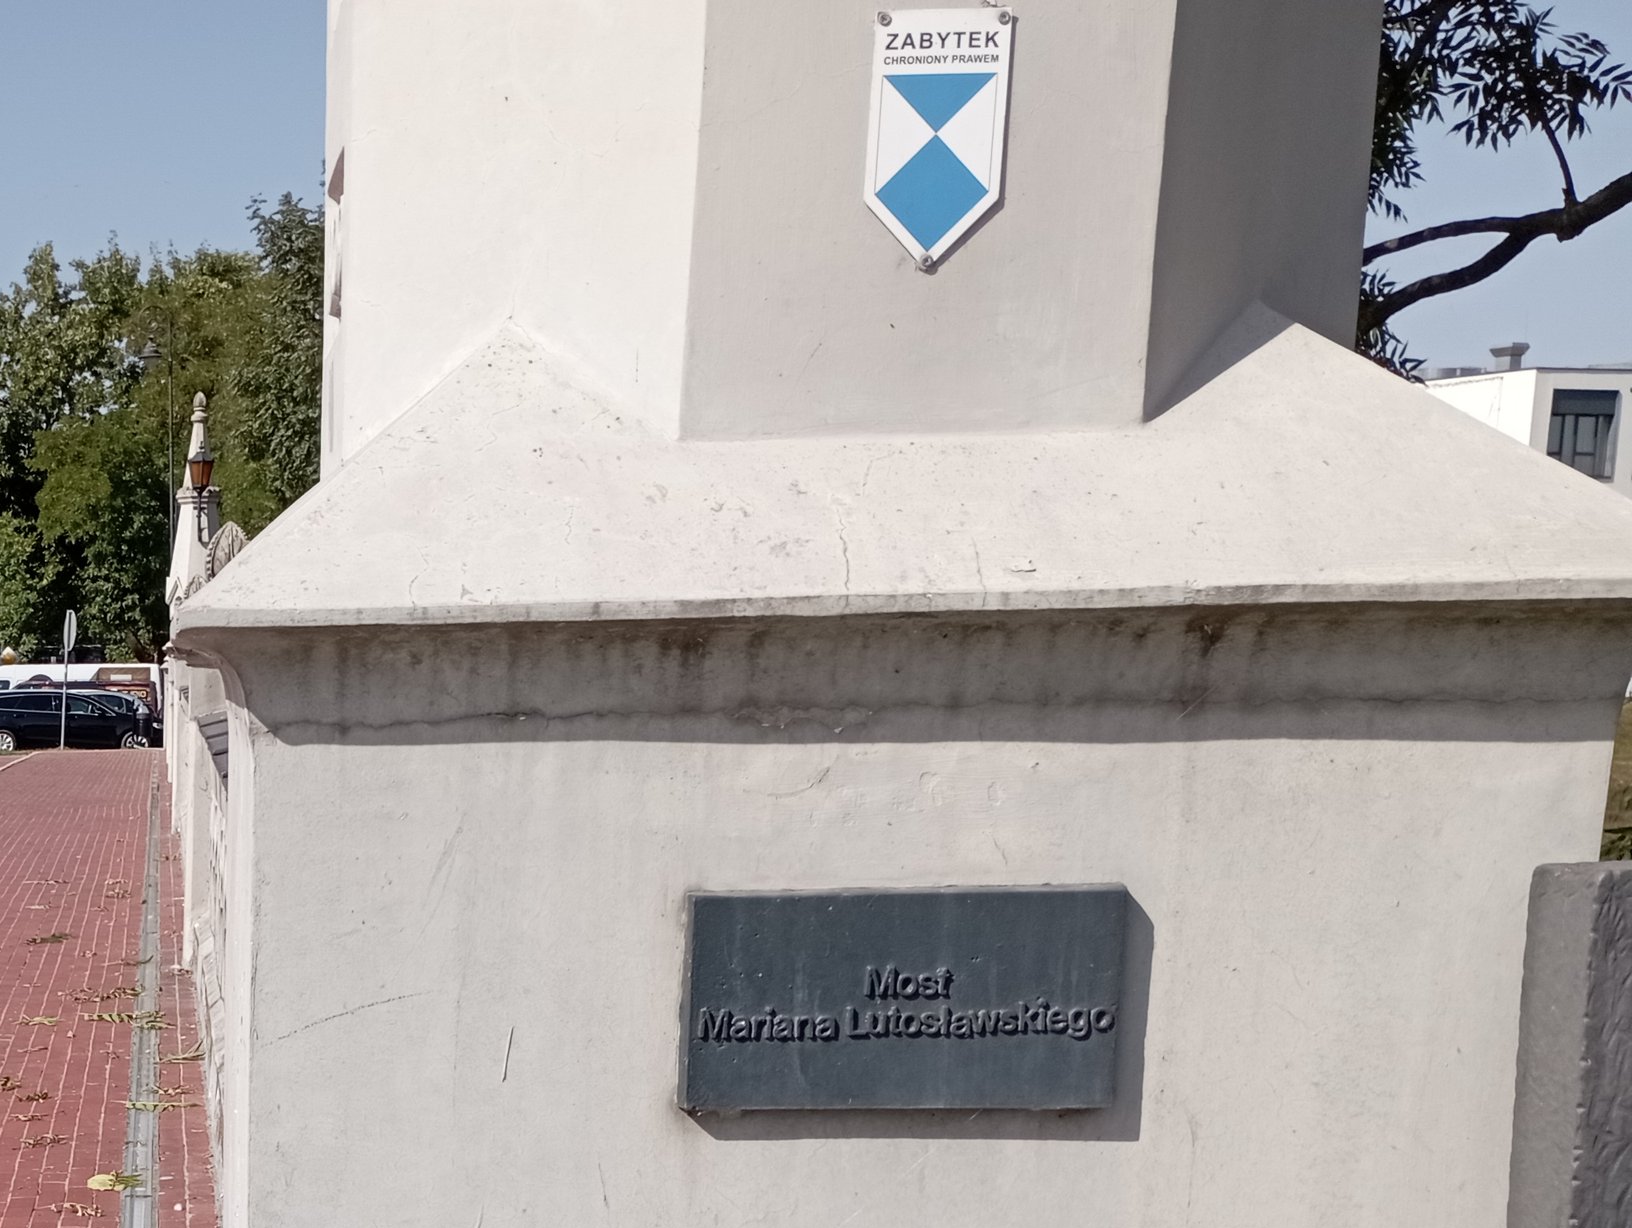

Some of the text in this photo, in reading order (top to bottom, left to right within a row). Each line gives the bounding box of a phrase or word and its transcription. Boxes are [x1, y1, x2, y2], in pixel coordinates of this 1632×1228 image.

[884, 30, 1000, 51] ZABYTEK
[883, 53, 1000, 66] CHRONIONY PRAWEM
[865, 965, 955, 1000] Most
[696, 998, 1117, 1044] Mariana Lutosławskiego
